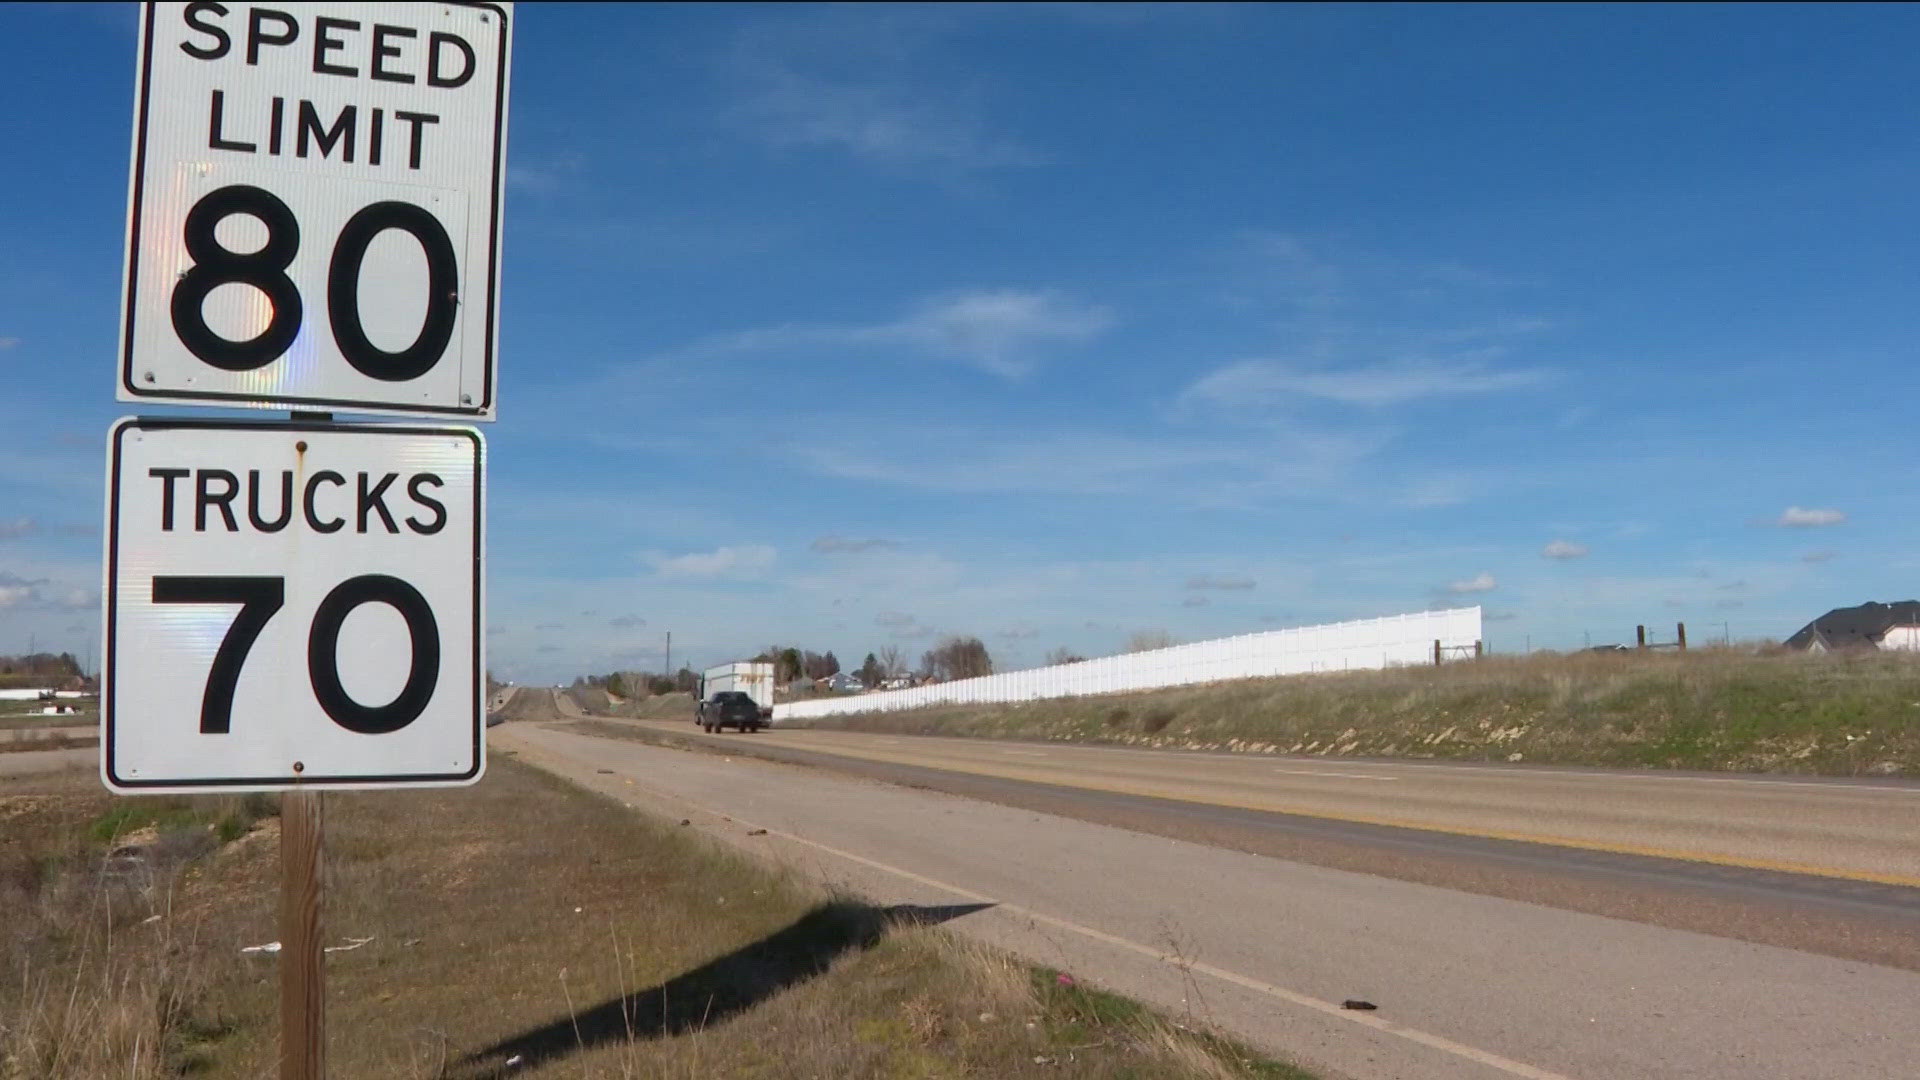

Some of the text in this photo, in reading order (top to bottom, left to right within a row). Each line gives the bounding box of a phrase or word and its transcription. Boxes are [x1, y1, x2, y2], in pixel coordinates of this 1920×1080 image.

[179, 2, 476, 89] SPEED
[208, 90, 440, 170] LIMIT
[171, 185, 459, 382] 80
[149, 468, 447, 535] TRUCKS
[152, 574, 440, 734] 70
